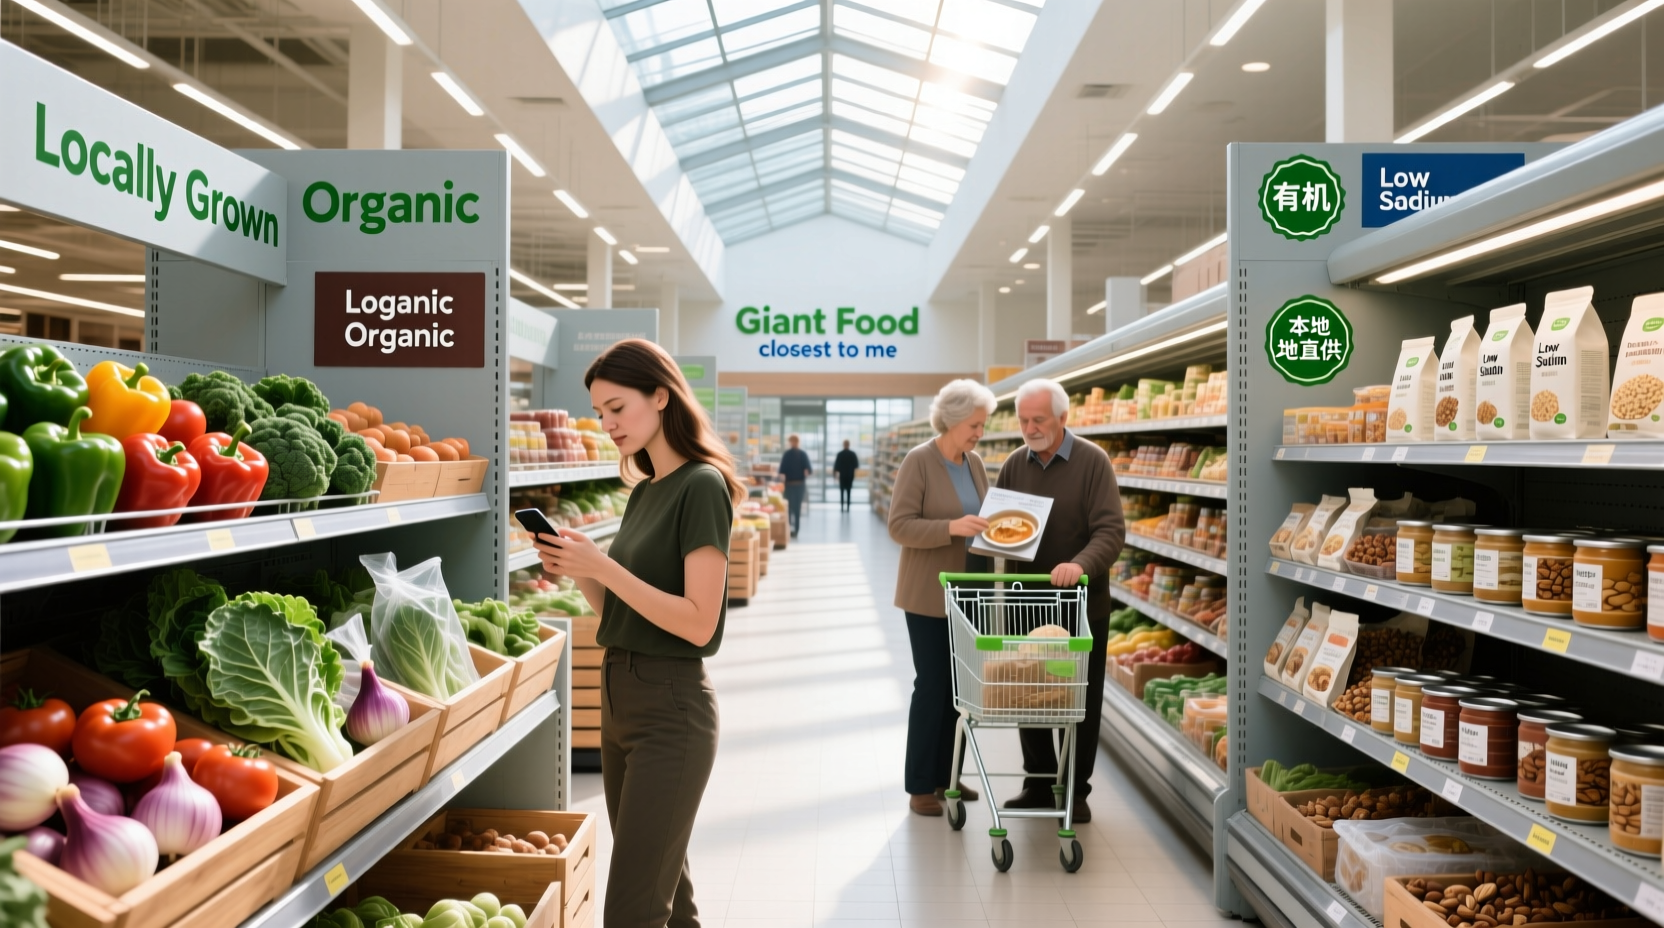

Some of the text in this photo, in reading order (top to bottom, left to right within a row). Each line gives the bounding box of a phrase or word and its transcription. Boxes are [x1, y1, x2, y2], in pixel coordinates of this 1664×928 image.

[35, 101, 279, 247] Locally Grown
[1380, 167, 1430, 188] Low
[302, 180, 480, 235] Organic
[1272, 181, 1331, 212] 有机
[345, 289, 454, 321] Loganic
[735, 305, 919, 336] Giant Food
[344, 321, 455, 354] Organic
[1288, 315, 1331, 337] 本地
[759, 339, 897, 358] closest to me
[1275, 338, 1343, 361] 地直供
